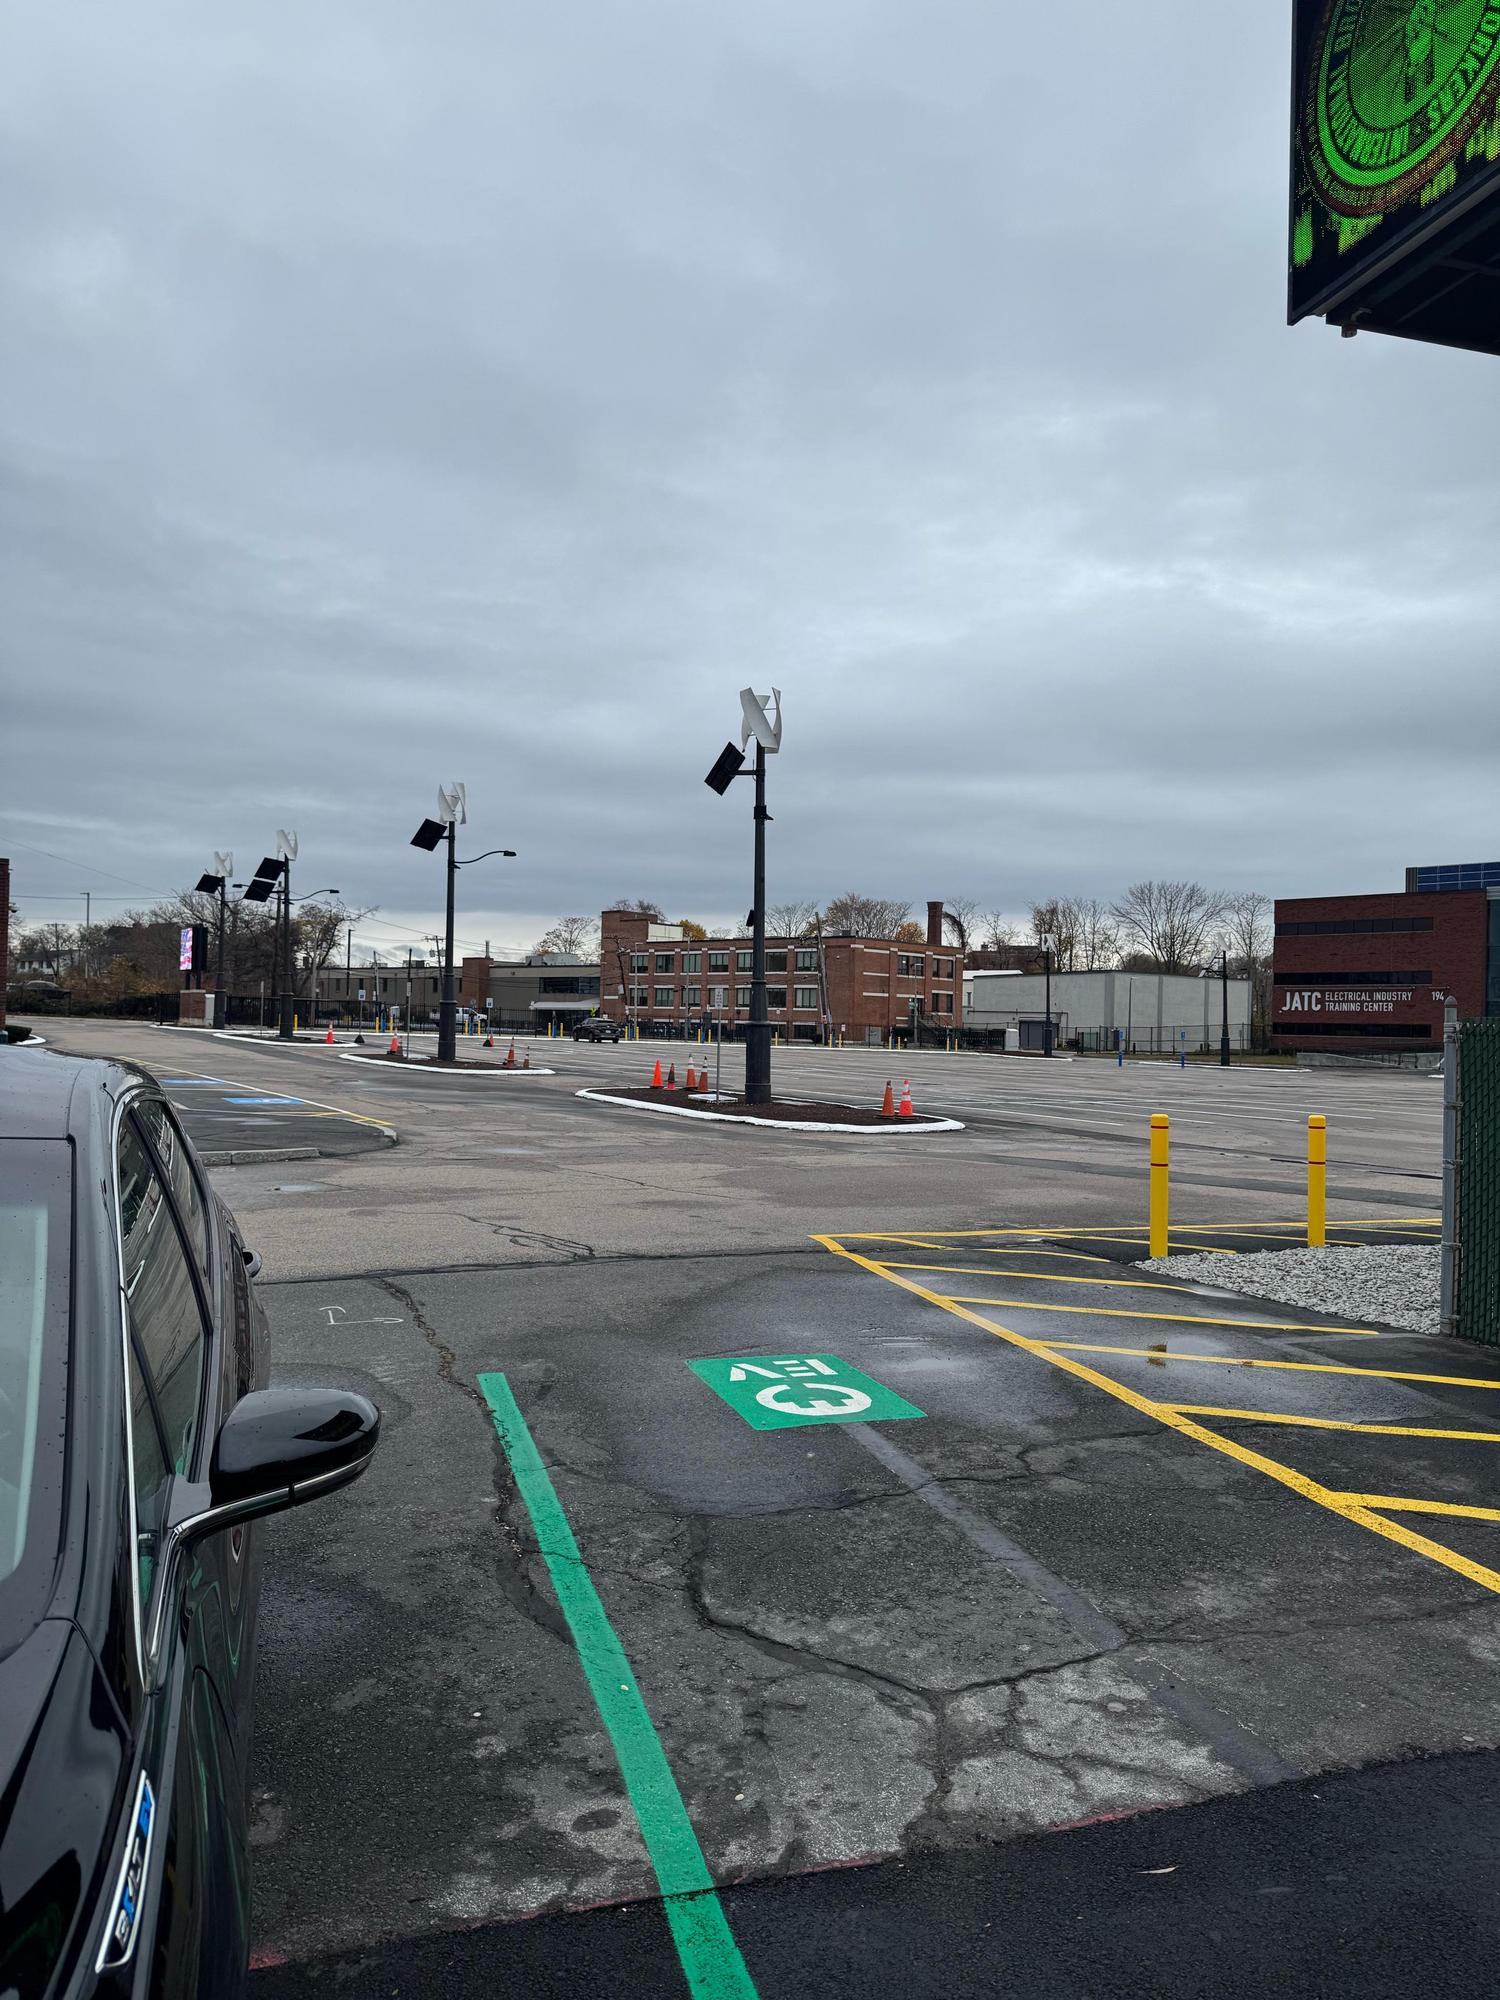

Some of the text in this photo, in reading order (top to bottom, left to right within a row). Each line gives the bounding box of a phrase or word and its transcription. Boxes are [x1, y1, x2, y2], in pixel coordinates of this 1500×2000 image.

[1328, 54, 1410, 166] INTERNATIONAL
[1282, 991, 1322, 1012] JATC
[1325, 991, 1412, 1001] ELECTRICAL INDUSTRY
[1431, 991, 1445, 1001] 194
[1325, 1002, 1394, 1012] TRAINING CENTER
[729, 1358, 839, 1382] EV
